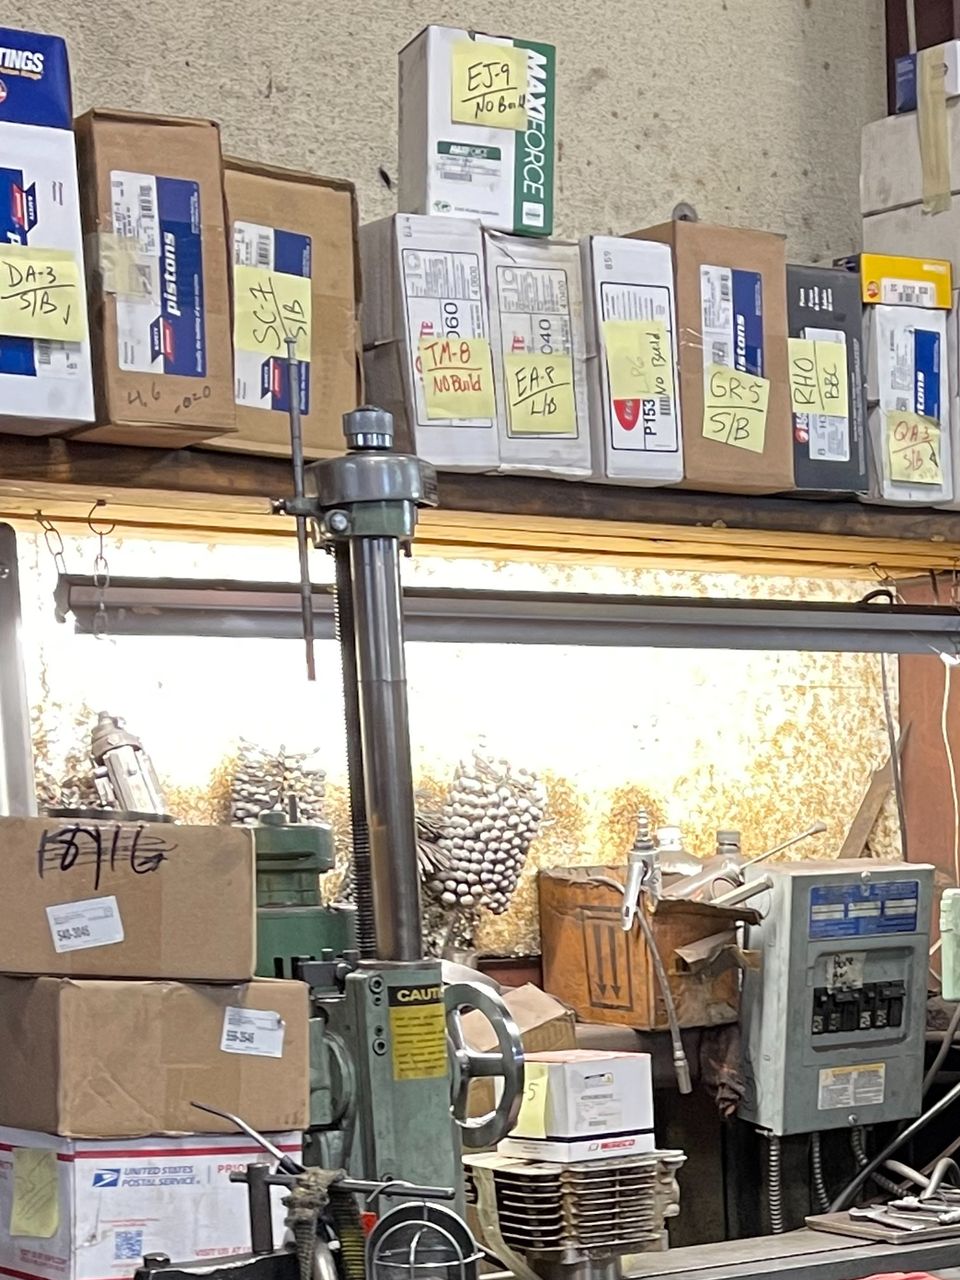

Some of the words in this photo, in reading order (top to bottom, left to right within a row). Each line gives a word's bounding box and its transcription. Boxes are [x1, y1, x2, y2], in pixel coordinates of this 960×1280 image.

[468, 62, 510, 91] EJ-9
[522, 49, 547, 199] MAXIFORCE
[2, 261, 57, 287] DA-3
[164, 232, 181, 317] pistons
[425, 341, 471, 367] TM-8
[710, 371, 763, 403] GR-5
[710, 411, 750, 444] S/B
[121, 1177, 157, 1187] POSTAL
[124, 1166, 159, 1177] UNITED
[161, 1165, 194, 1175] STATES
